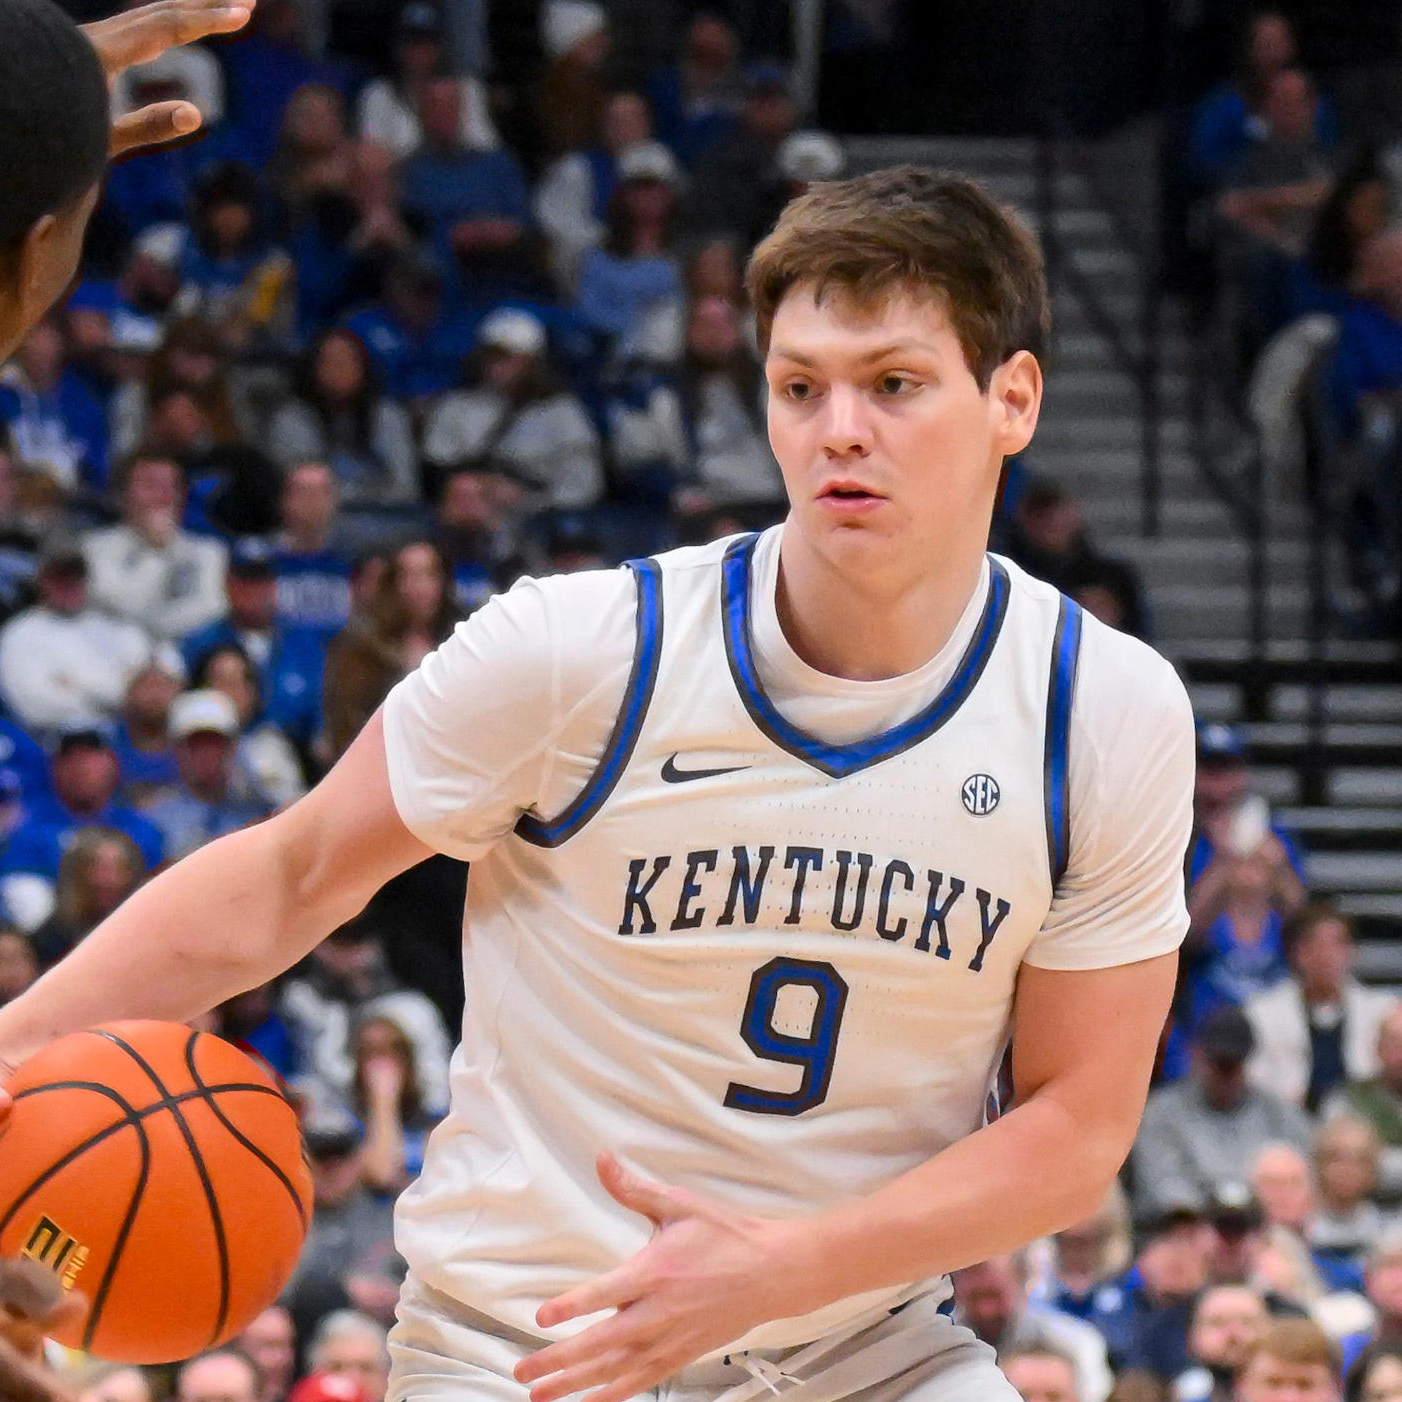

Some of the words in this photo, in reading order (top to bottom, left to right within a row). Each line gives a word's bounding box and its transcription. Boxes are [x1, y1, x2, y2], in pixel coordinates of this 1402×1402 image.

[962, 774, 1000, 815] SEC
[617, 845, 1011, 973] KENTUCKY
[723, 956, 850, 1117] 9
